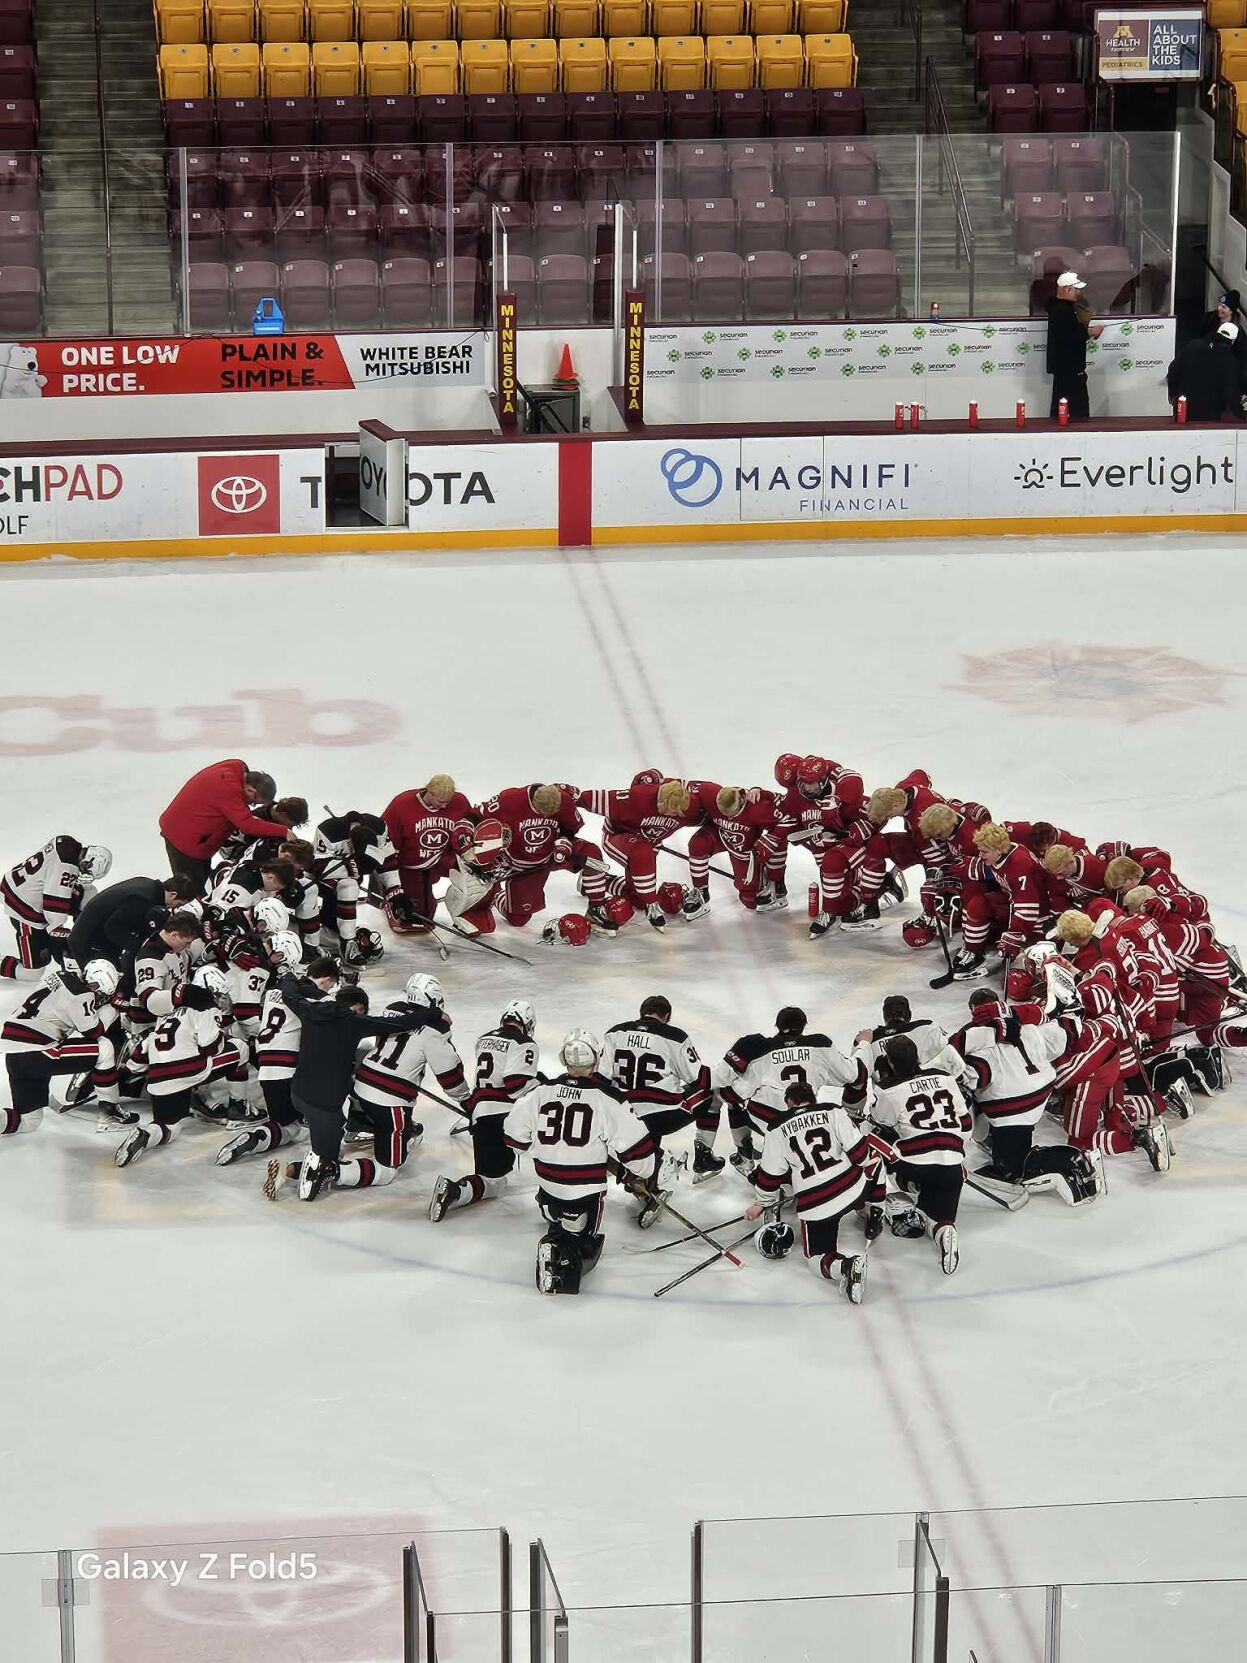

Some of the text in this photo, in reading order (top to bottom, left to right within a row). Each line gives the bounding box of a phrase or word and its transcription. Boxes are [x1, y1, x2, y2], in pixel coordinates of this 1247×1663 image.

[1153, 24, 1178, 35] ALL
[1106, 38, 1141, 47] HEALTH
[1154, 34, 1198, 45] ABOUT
[1153, 45, 1177, 55] THE
[1152, 55, 1181, 65] KIDS
[61, 344, 180, 366] ONE LOW
[221, 342, 324, 362] PLAIN &
[360, 345, 473, 361] WHITE BEAR
[501, 305, 514, 413] MINNESOTA
[628, 302, 643, 410] MINNESOTA
[365, 361, 470, 377] MITSUBISHI
[62, 372, 146, 393] PRICE.
[220, 368, 323, 389] SIMPLE.
[736, 464, 910, 491] MAGNIFI
[1060, 455, 1234, 493] Everlight
[300, 476, 322, 508] T
[800, 498, 908, 512] FINANCIAL
[426, 833, 442, 844] M
[530, 830, 547, 840] M
[1018, 875, 1027, 891] 7
[221, 889, 240, 904] 15
[138, 967, 154, 983] 29
[627, 1034, 650, 1049] HALL
[367, 1032, 411, 1070] 11
[525, 1049, 534, 1065] 2
[771, 1048, 811, 1065] SOULAR
[476, 1052, 494, 1088] 2
[612, 1049, 666, 1090] 36
[556, 1086, 582, 1100] JOHN
[905, 1089, 960, 1131] 23
[538, 1101, 593, 1147] 30
[780, 1112, 829, 1137] NYBAKKEN
[789, 1127, 843, 1180] 12
